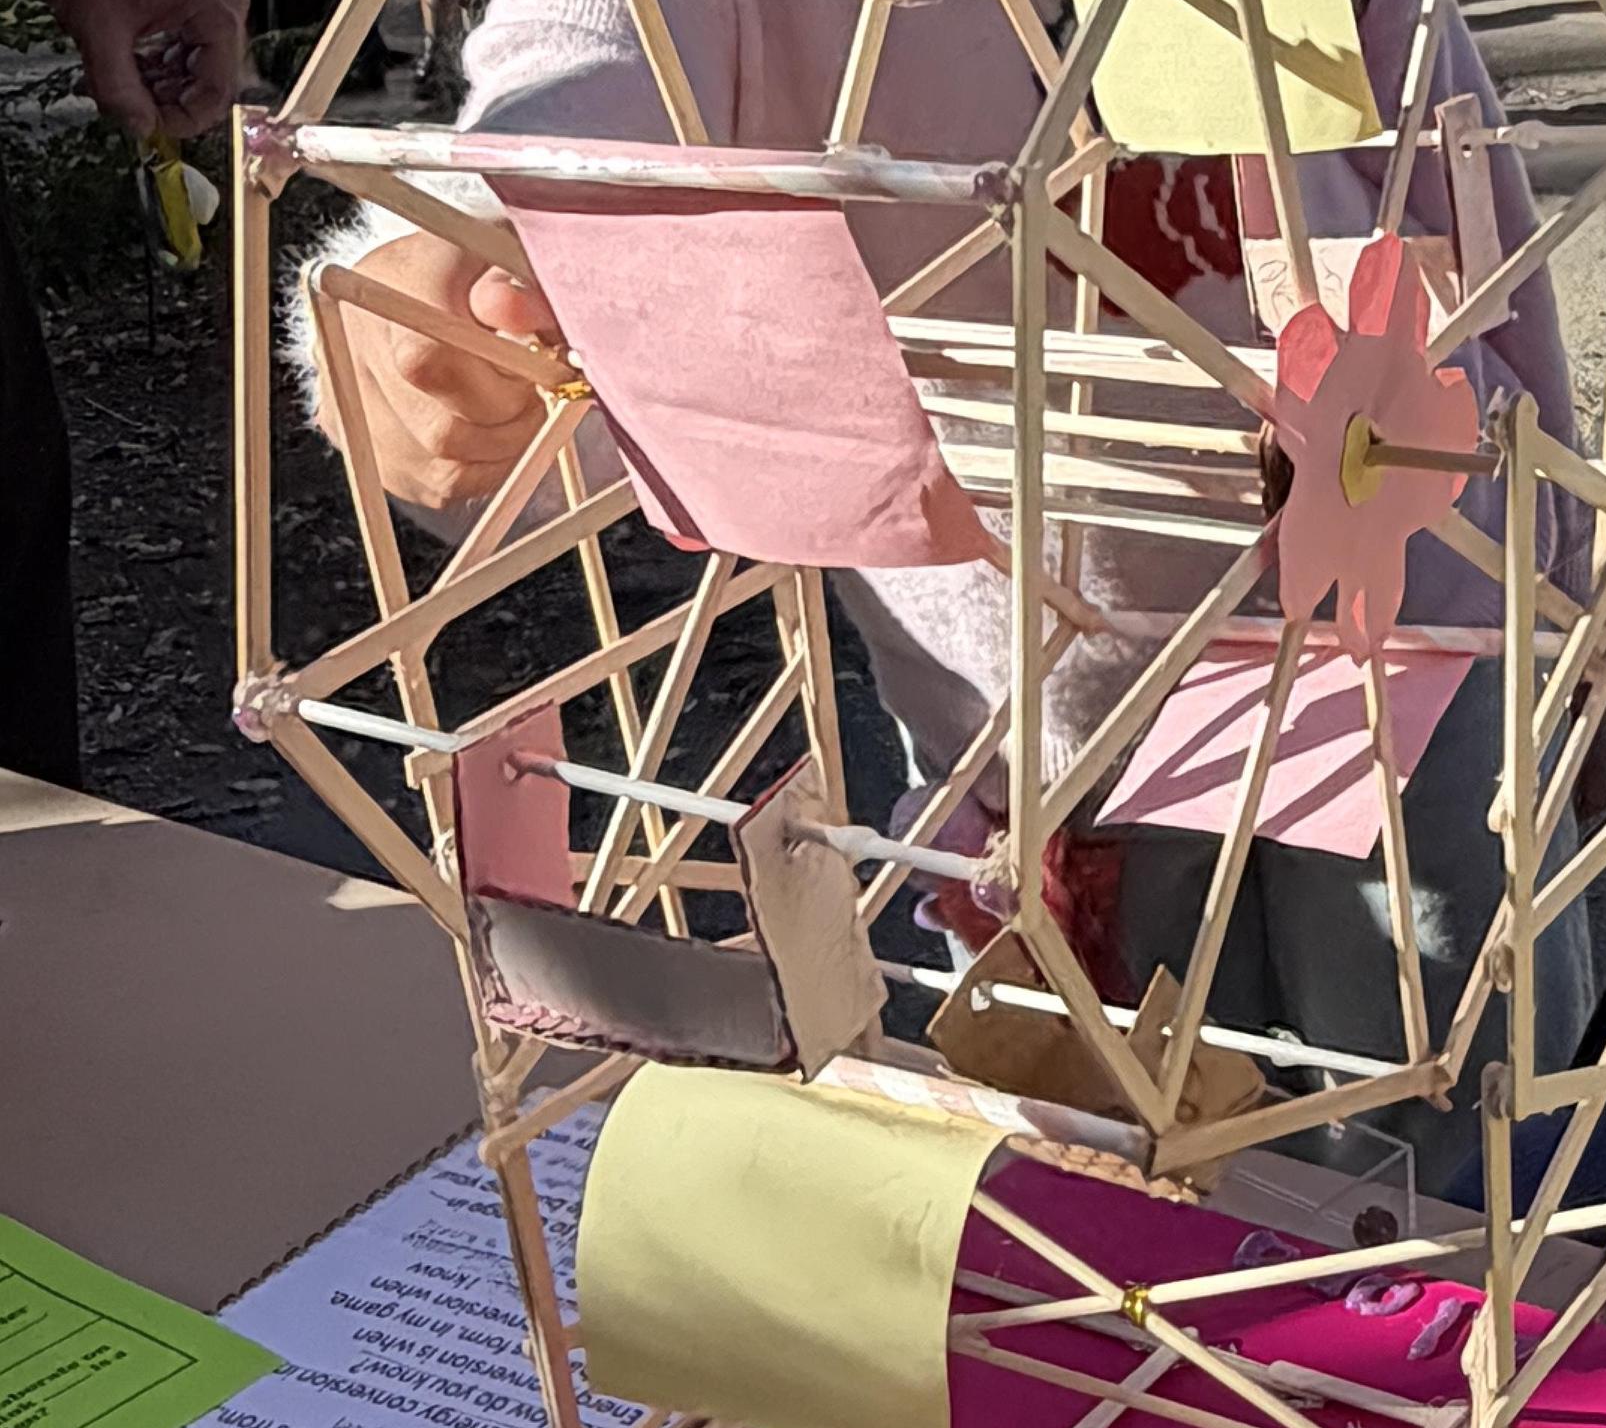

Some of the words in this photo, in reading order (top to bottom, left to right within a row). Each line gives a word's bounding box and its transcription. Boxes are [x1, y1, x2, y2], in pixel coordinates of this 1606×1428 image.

[369, 1275, 433, 1302] when
[405, 1261, 472, 1290] know
[463, 1276, 482, 1291] I
[392, 1307, 432, 1328] my
[428, 1319, 455, 1339] In
[352, 1327, 417, 1355] when
[457, 1325, 513, 1356] form.
[415, 1344, 440, 1365] is
[348, 1357, 434, 1392] know?
[295, 1368, 420, 1414] conversion
[427, 1376, 479, 1402] you
[472, 1391, 512, 1413] do
[575, 1389, 644, 1427] Energ
